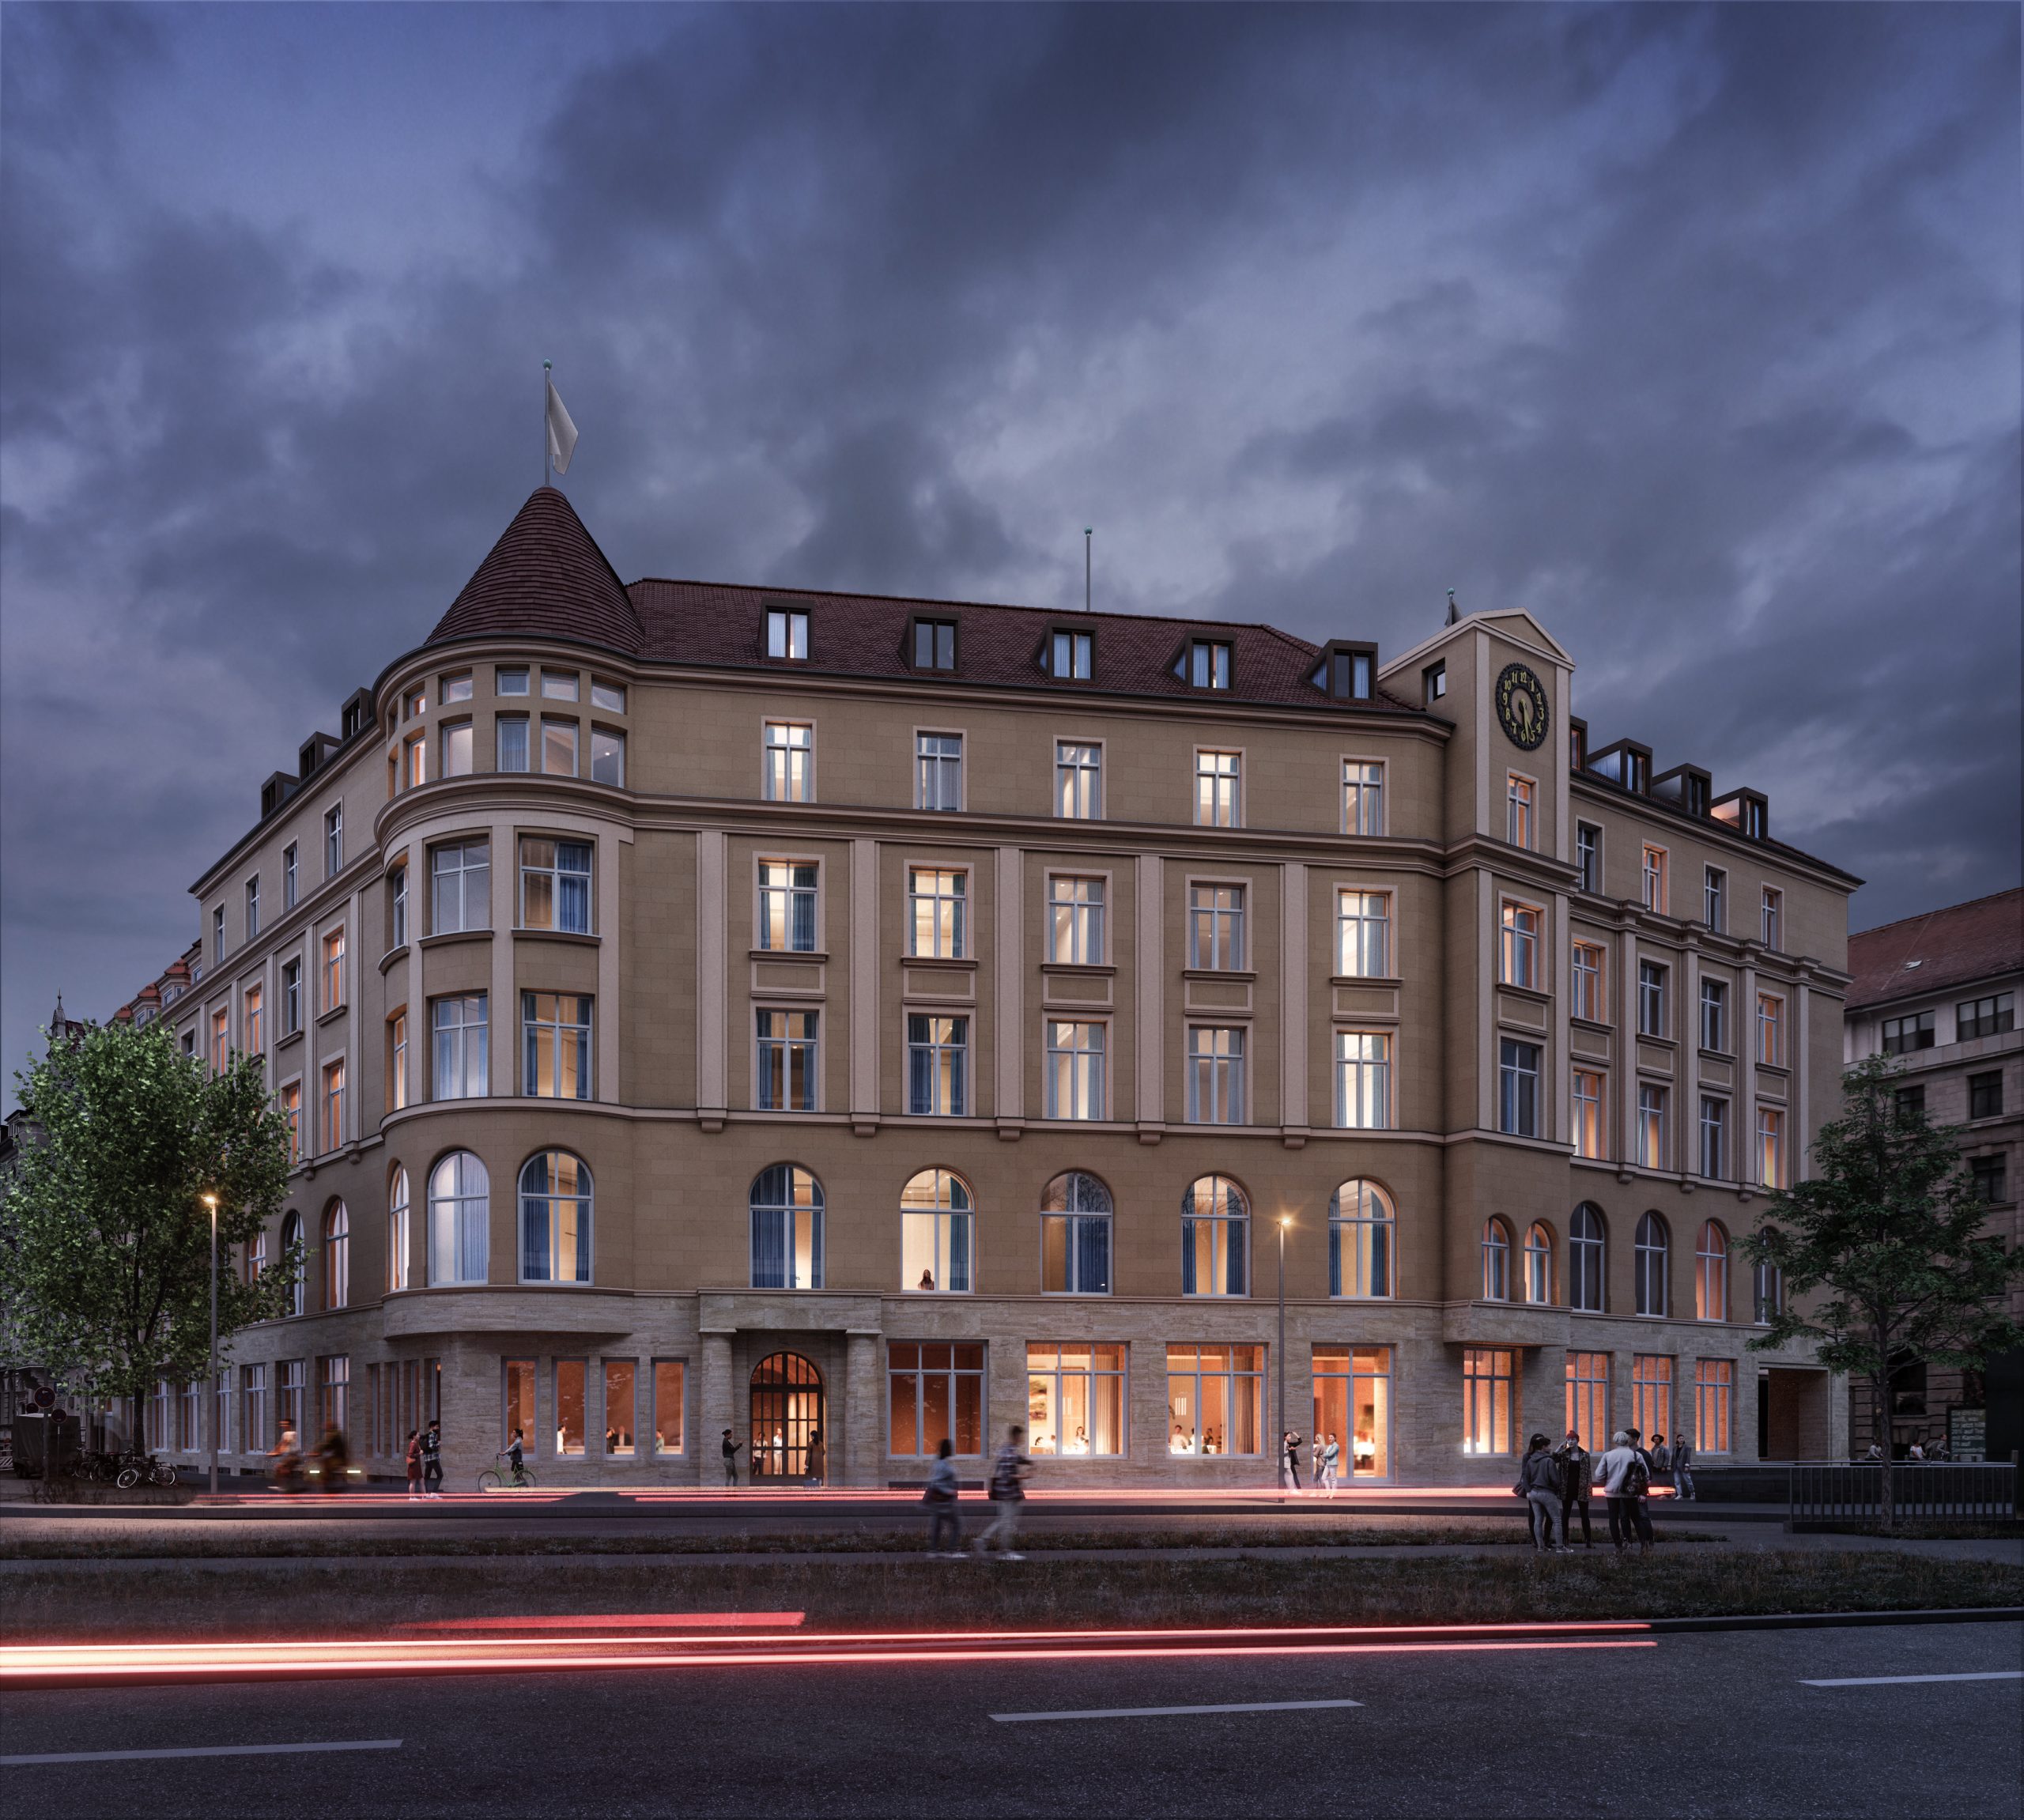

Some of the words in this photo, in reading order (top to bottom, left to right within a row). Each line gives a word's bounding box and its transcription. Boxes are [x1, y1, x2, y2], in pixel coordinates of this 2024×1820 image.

[1511, 671, 1518, 684] 11
[1520, 671, 1527, 683] 12
[1504, 679, 1512, 691] 10
[1530, 679, 1535, 692] 1
[1502, 692, 1509, 705] 9
[1536, 693, 1542, 704] 2
[1505, 708, 1511, 720] 8
[1539, 708, 1544, 720] 3
[1511, 721, 1517, 734] 7
[1535, 721, 1542, 734] 4
[1520, 730, 1526, 742] 6
[1530, 730, 1535, 742] 5
